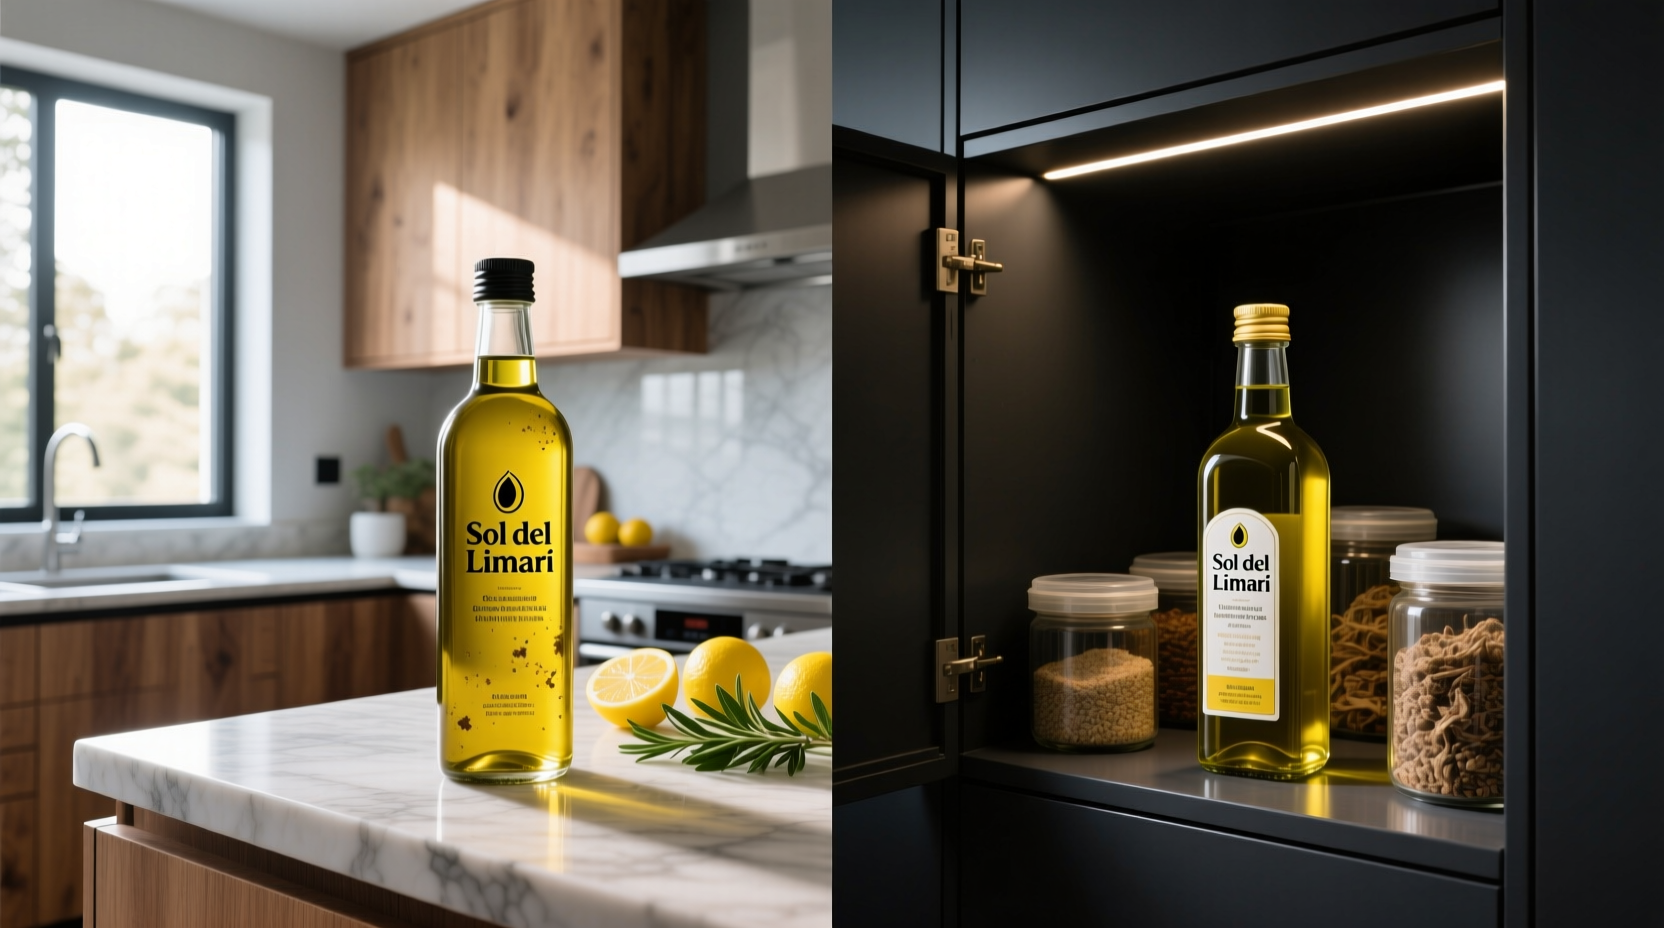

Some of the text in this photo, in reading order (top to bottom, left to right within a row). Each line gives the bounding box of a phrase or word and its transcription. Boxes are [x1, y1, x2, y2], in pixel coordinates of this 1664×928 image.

[466, 521, 552, 545] Sol del
[1213, 553, 1269, 571] Sol del
